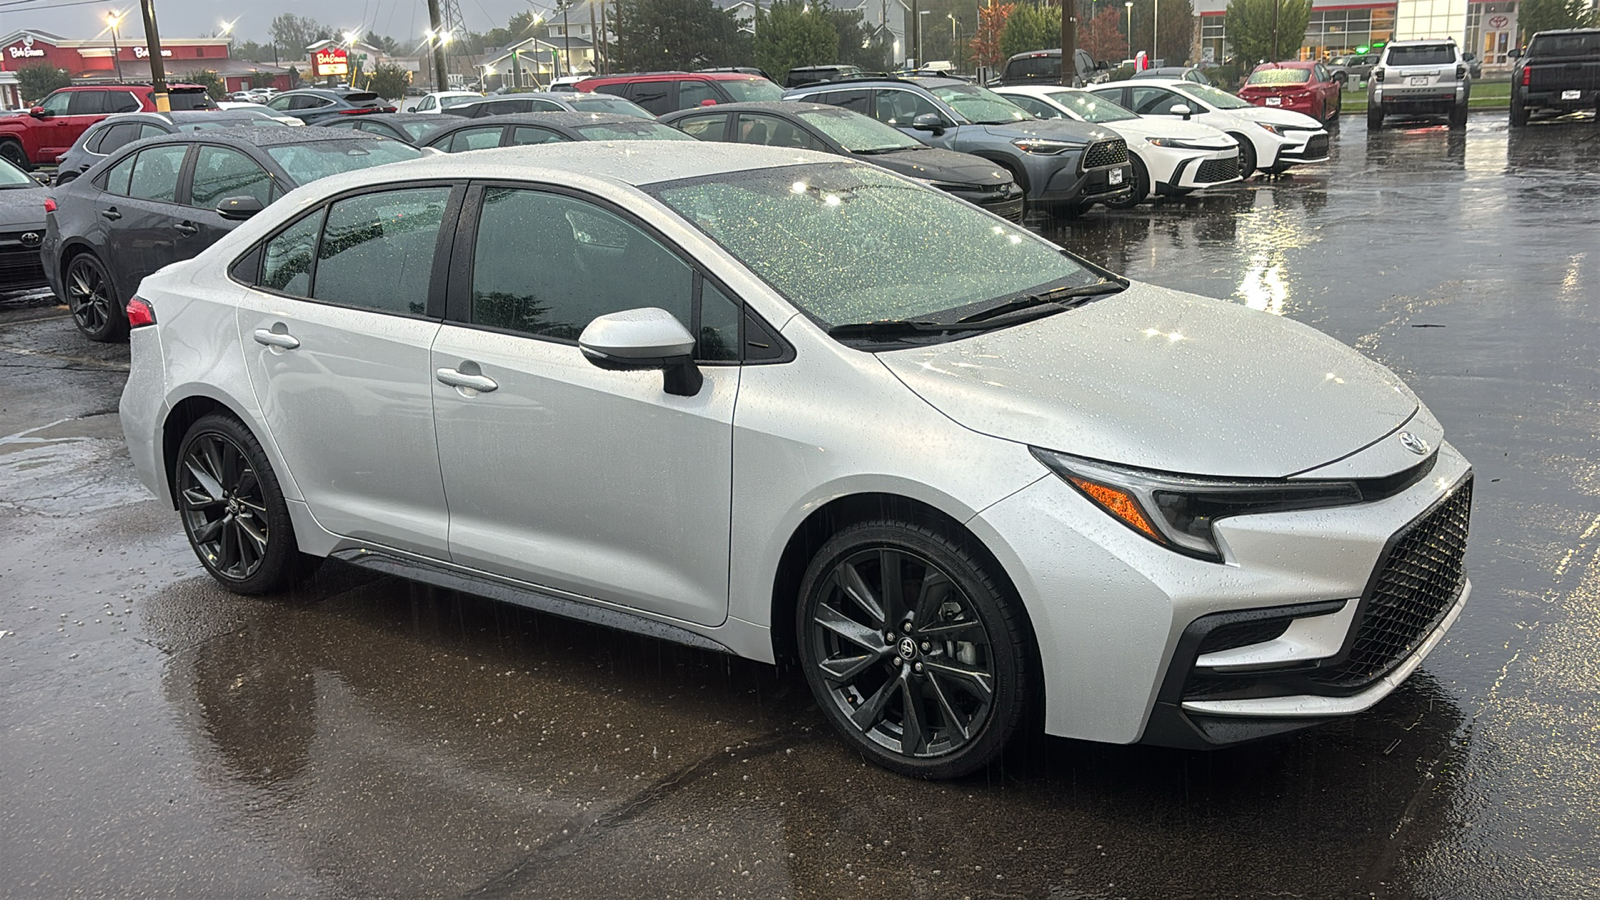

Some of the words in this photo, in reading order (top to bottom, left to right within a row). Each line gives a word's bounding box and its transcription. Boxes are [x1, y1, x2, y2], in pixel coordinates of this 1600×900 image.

[9, 47, 24, 58] Bob
[24, 47, 44, 57] Evans
[317, 53, 330, 64] Bob
[329, 53, 347, 63] Evans
